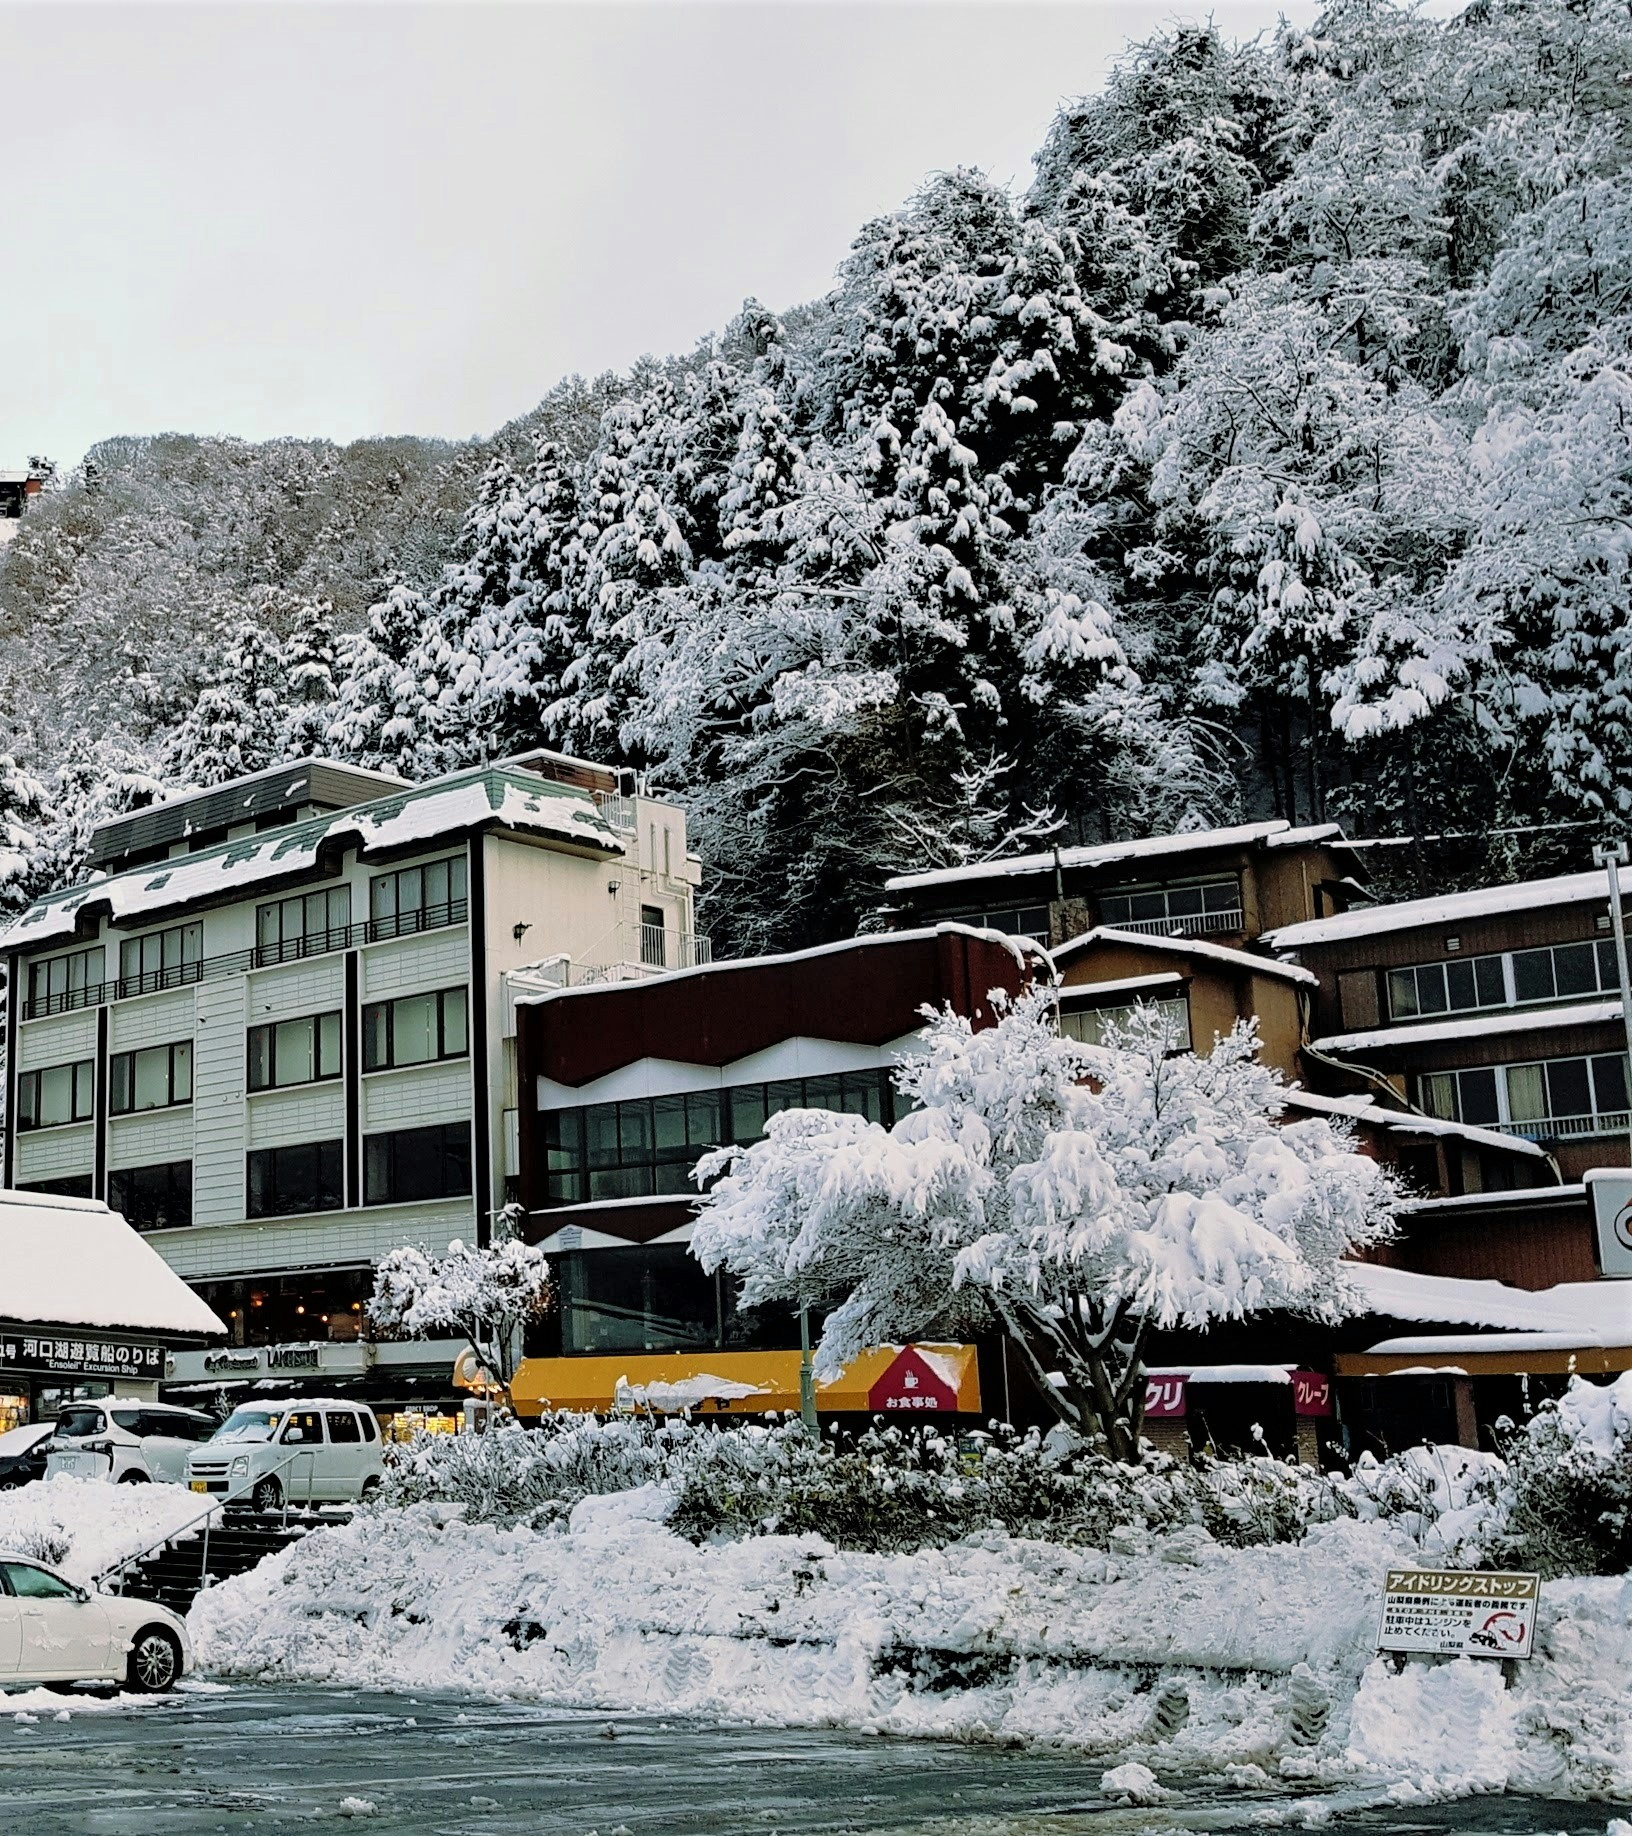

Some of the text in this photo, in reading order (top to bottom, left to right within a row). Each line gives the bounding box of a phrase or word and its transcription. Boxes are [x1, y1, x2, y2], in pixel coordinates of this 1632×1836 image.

[23, 1338, 160, 1367] 河口湖遊覧船のりば
[83, 1361, 120, 1373] Excursion
[121, 1364, 138, 1375] Ship
[886, 1396, 938, 1409] お食事処
[1389, 1573, 1534, 1596] アイドリングストップ
[1386, 1616, 1471, 1628] 駐車中はエンジンを
